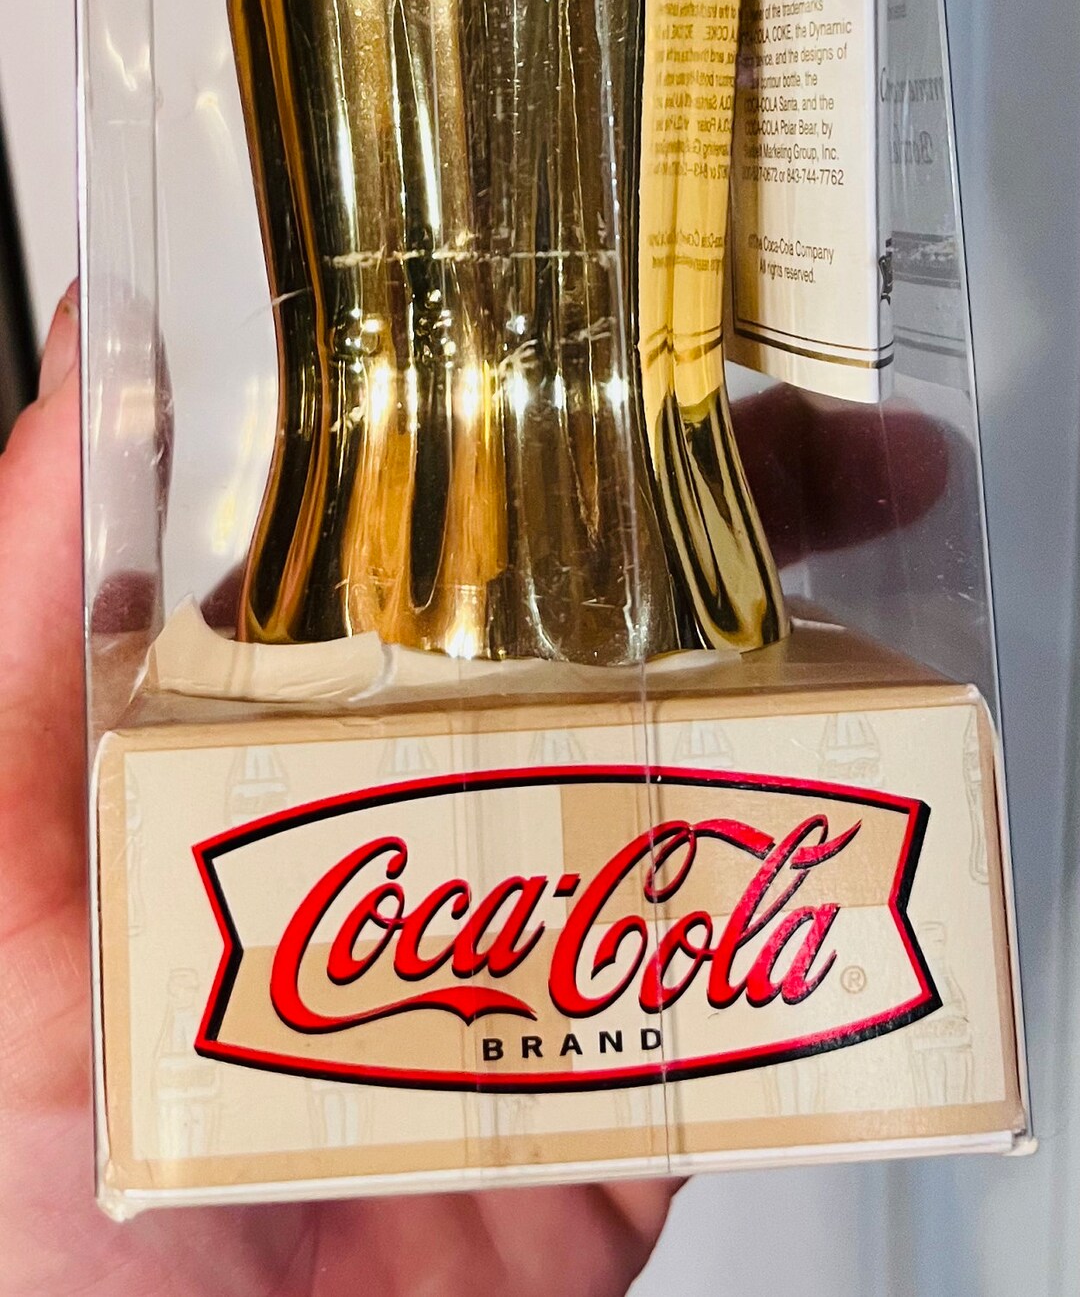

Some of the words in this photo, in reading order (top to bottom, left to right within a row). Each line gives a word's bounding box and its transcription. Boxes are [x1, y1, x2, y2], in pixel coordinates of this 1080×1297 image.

[795, 22, 807, 39] the
[809, 19, 852, 40] Dynamic
[801, 45, 834, 66] designs
[837, 43, 847, 60] of
[804, 70, 817, 86] the
[802, 93, 817, 111] and
[819, 93, 834, 111] the
[821, 119, 833, 139] by
[821, 143, 840, 161] Inc.
[787, 168, 845, 186] 843-744-7762
[763, 236, 794, 256] Coca-Cola
[795, 240, 834, 265] Company
[270, 813, 863, 1036] Coca-Cola
[482, 1026, 665, 1063] BRAND
